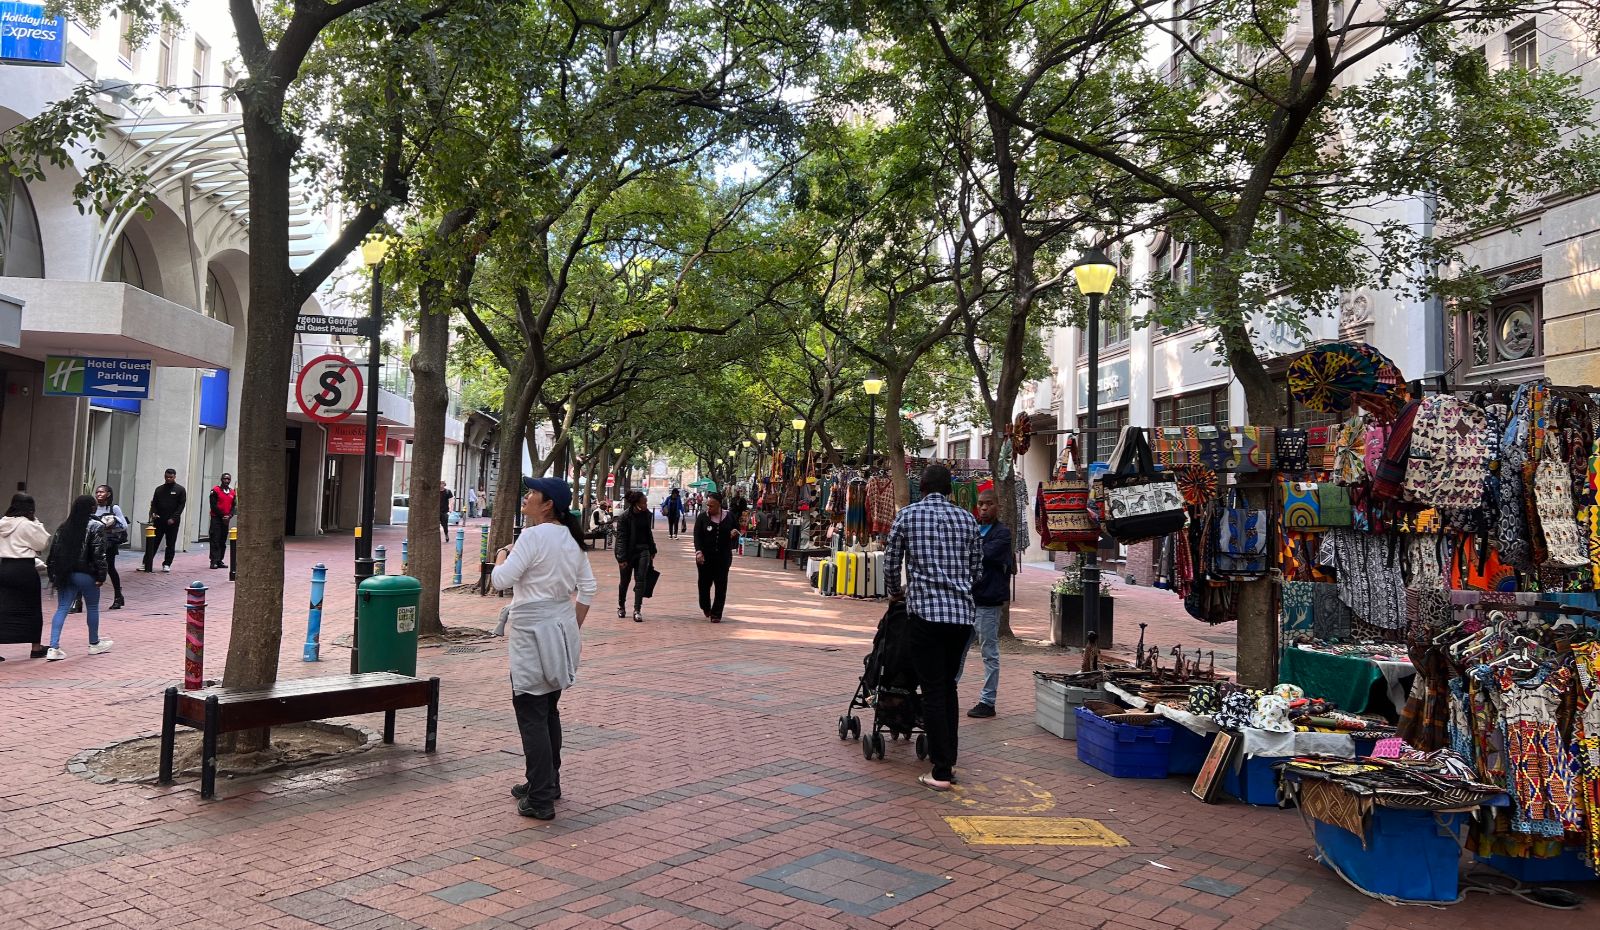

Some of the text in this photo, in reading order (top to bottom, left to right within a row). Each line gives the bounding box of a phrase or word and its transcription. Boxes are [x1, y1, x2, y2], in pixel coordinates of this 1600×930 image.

[2, 12, 40, 26] Holiday
[3, 24, 56, 40] Express
[297, 316, 358, 327] rgeous George
[330, 326, 358, 334] Parking
[87, 360, 151, 370] Hotel Guest
[97, 371, 139, 382] Parking
[313, 370, 346, 407] S
